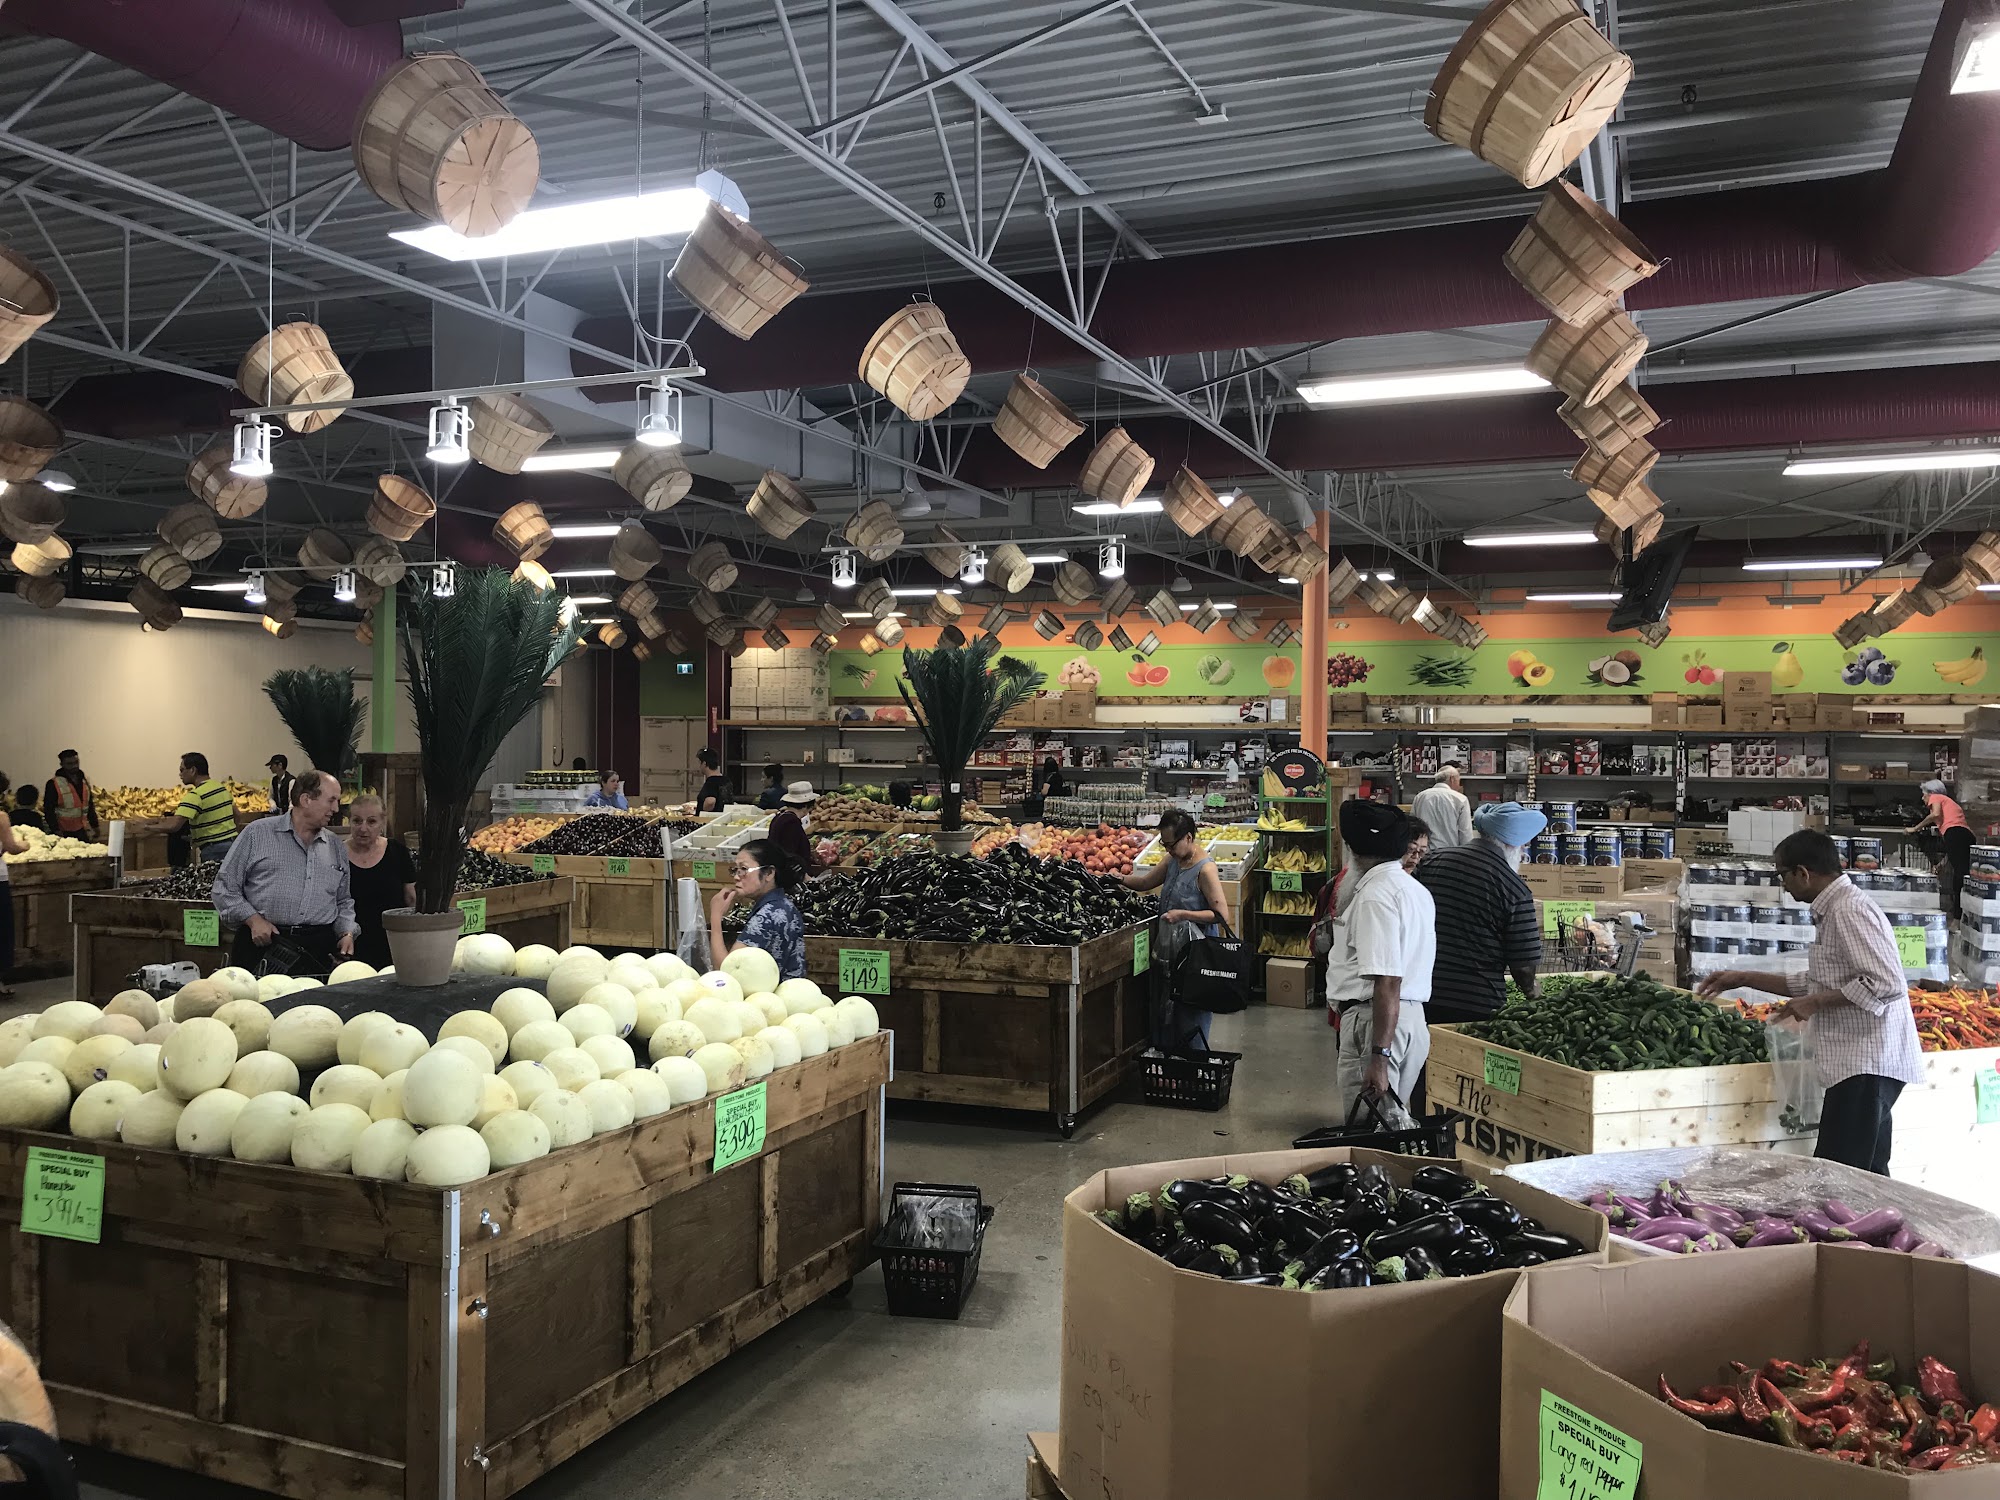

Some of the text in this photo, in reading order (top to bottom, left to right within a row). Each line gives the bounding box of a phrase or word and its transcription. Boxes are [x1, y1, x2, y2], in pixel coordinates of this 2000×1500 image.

[1758, 908, 1781, 916] SUCCESS
[1219, 970, 1238, 979] MARKET
[726, 1099, 758, 1116] SPECIAL BUY
[1455, 1074, 1492, 1117] The
[1432, 1101, 1578, 1164] ISFIT
[40, 1164, 90, 1178] SPECIAL BUY
[1553, 1401, 1627, 1448] FREESTONE PRODUCE
[1558, 1420, 1621, 1465] SPECIAL BUY
[1549, 1429, 1626, 1493] Long red pepper
